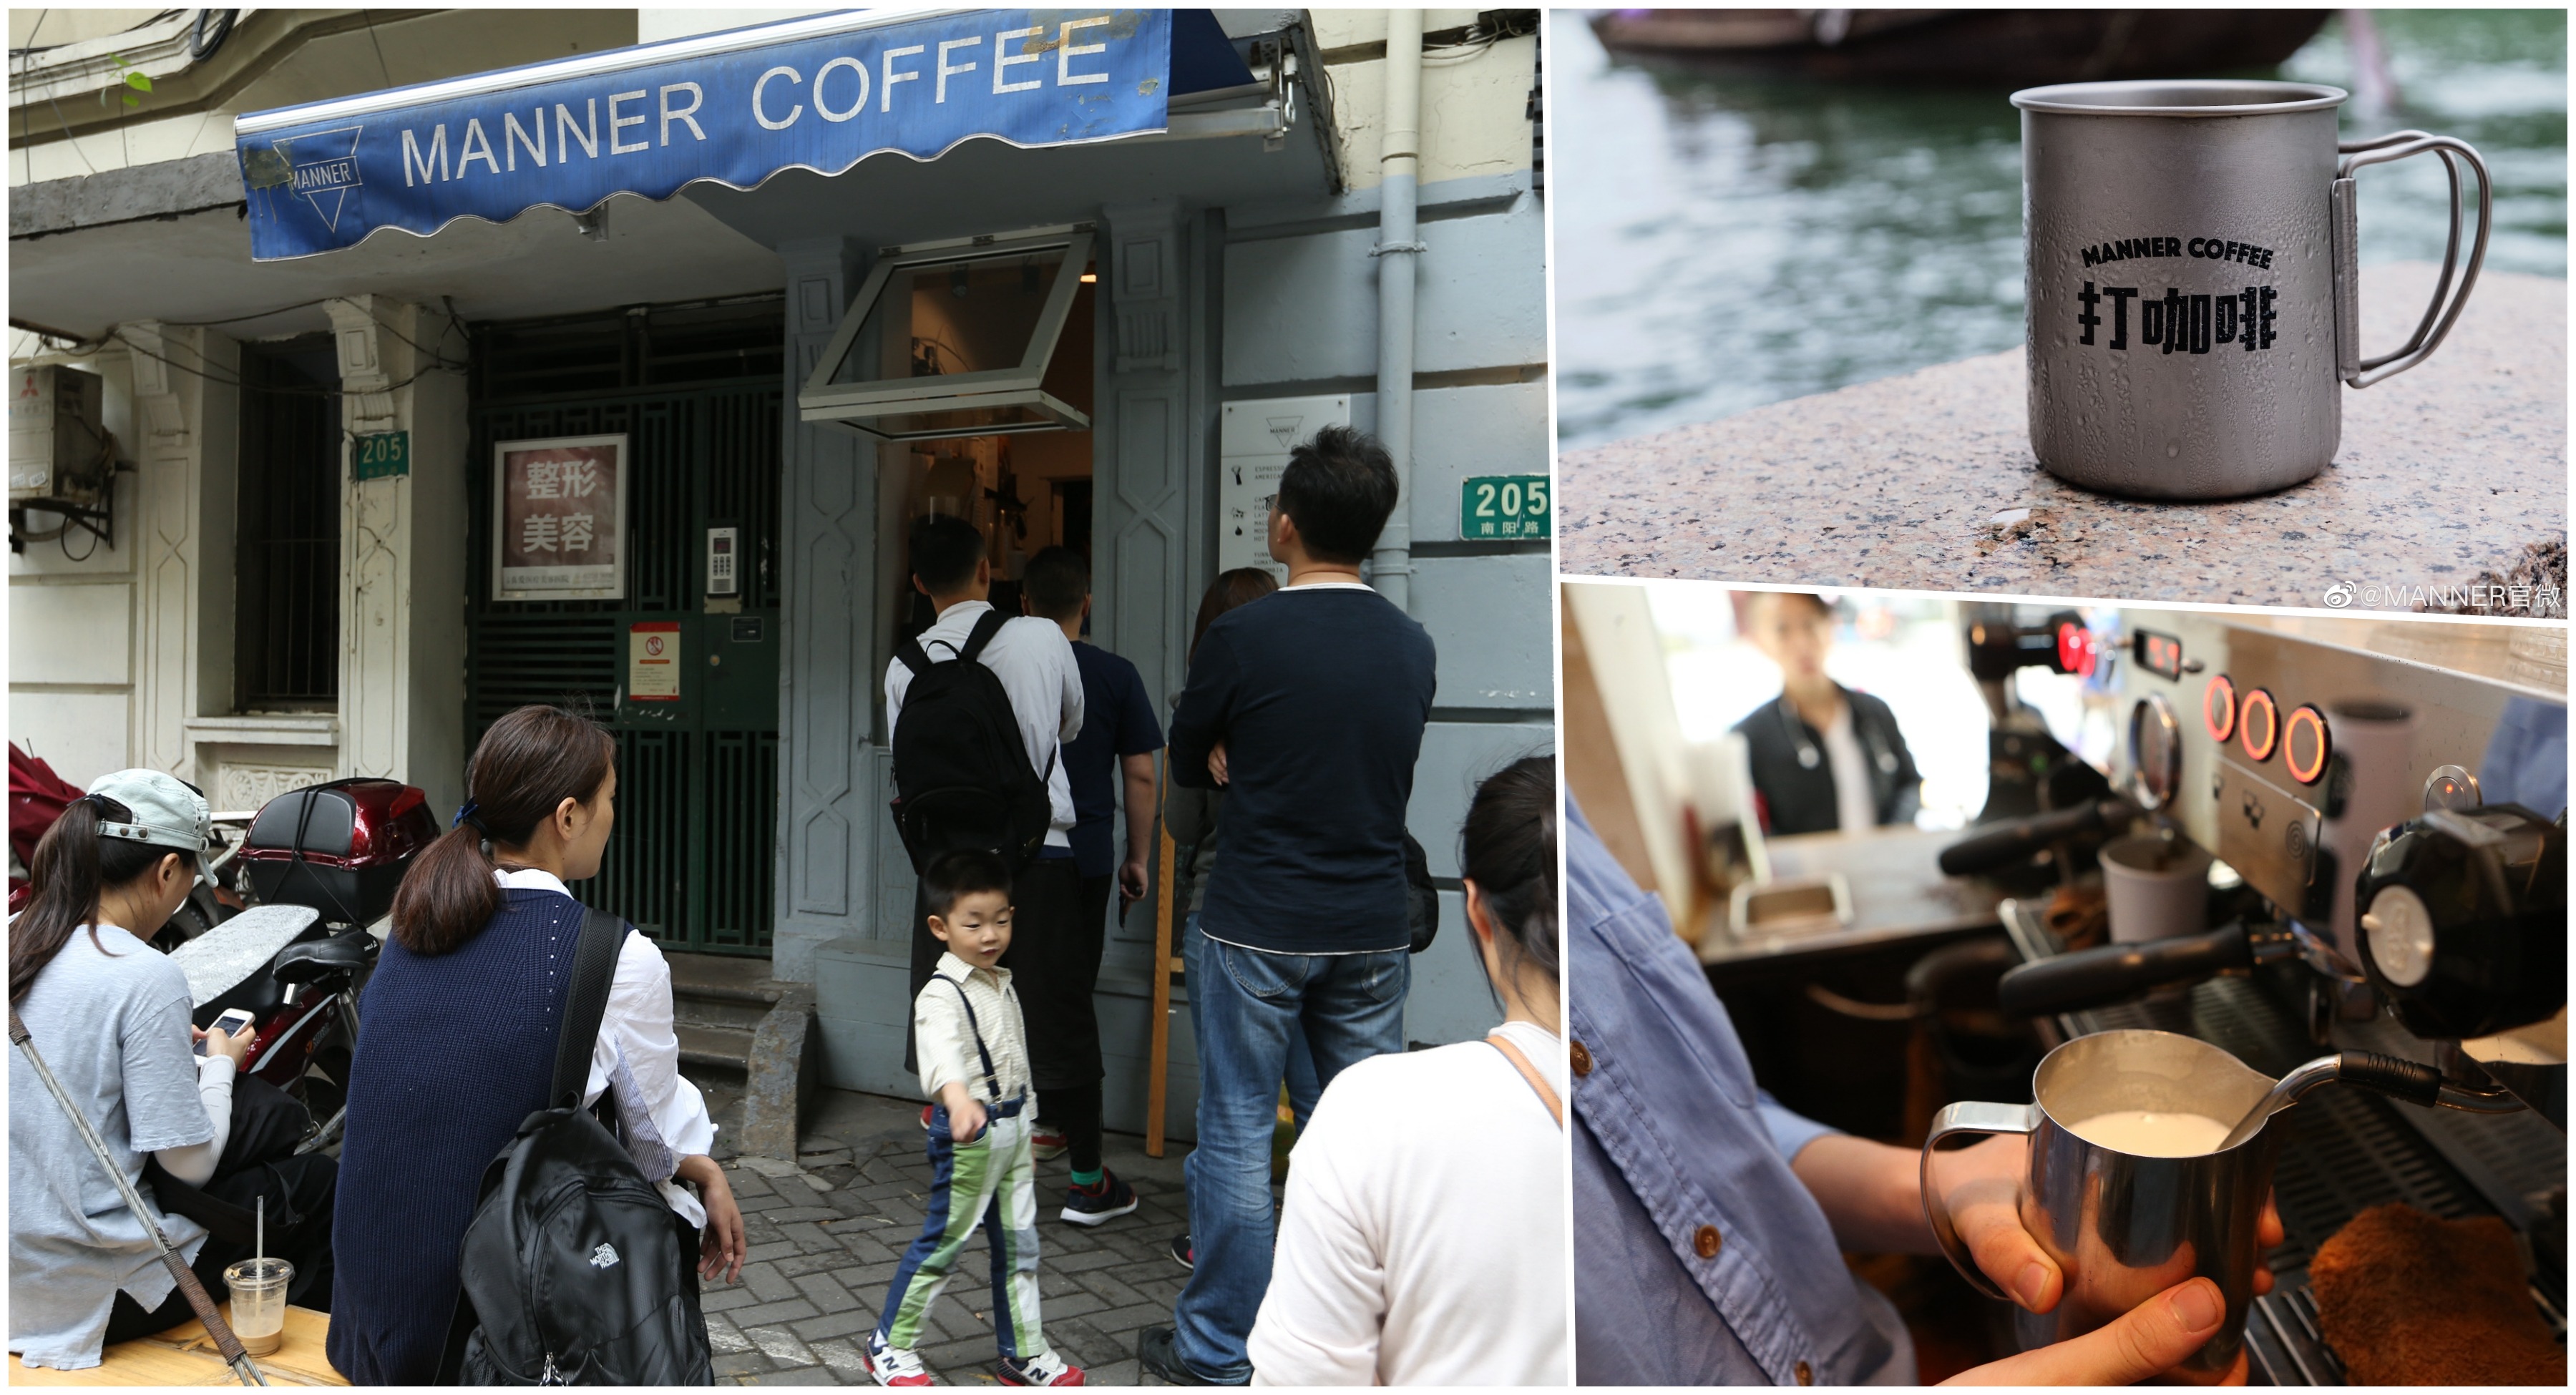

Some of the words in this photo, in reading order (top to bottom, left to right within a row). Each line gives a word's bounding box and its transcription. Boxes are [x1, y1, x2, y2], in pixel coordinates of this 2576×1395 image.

[401, 81, 706, 187] MANNER
[751, 15, 1110, 131] COFFEE
[290, 162, 352, 191] MANNER
[2081, 237, 2182, 268] MANNER
[2187, 237, 2274, 270] COFFEE
[2077, 280, 2277, 355] 打咖啡
[363, 437, 401, 464] 205
[526, 459, 597, 499] 整形
[1475, 481, 1548, 517] 205
[523, 512, 594, 553] 美容
[1480, 521, 1539, 535] 南阳路
[882, 1356, 900, 1371] N
[1029, 1367, 1048, 1381] N
